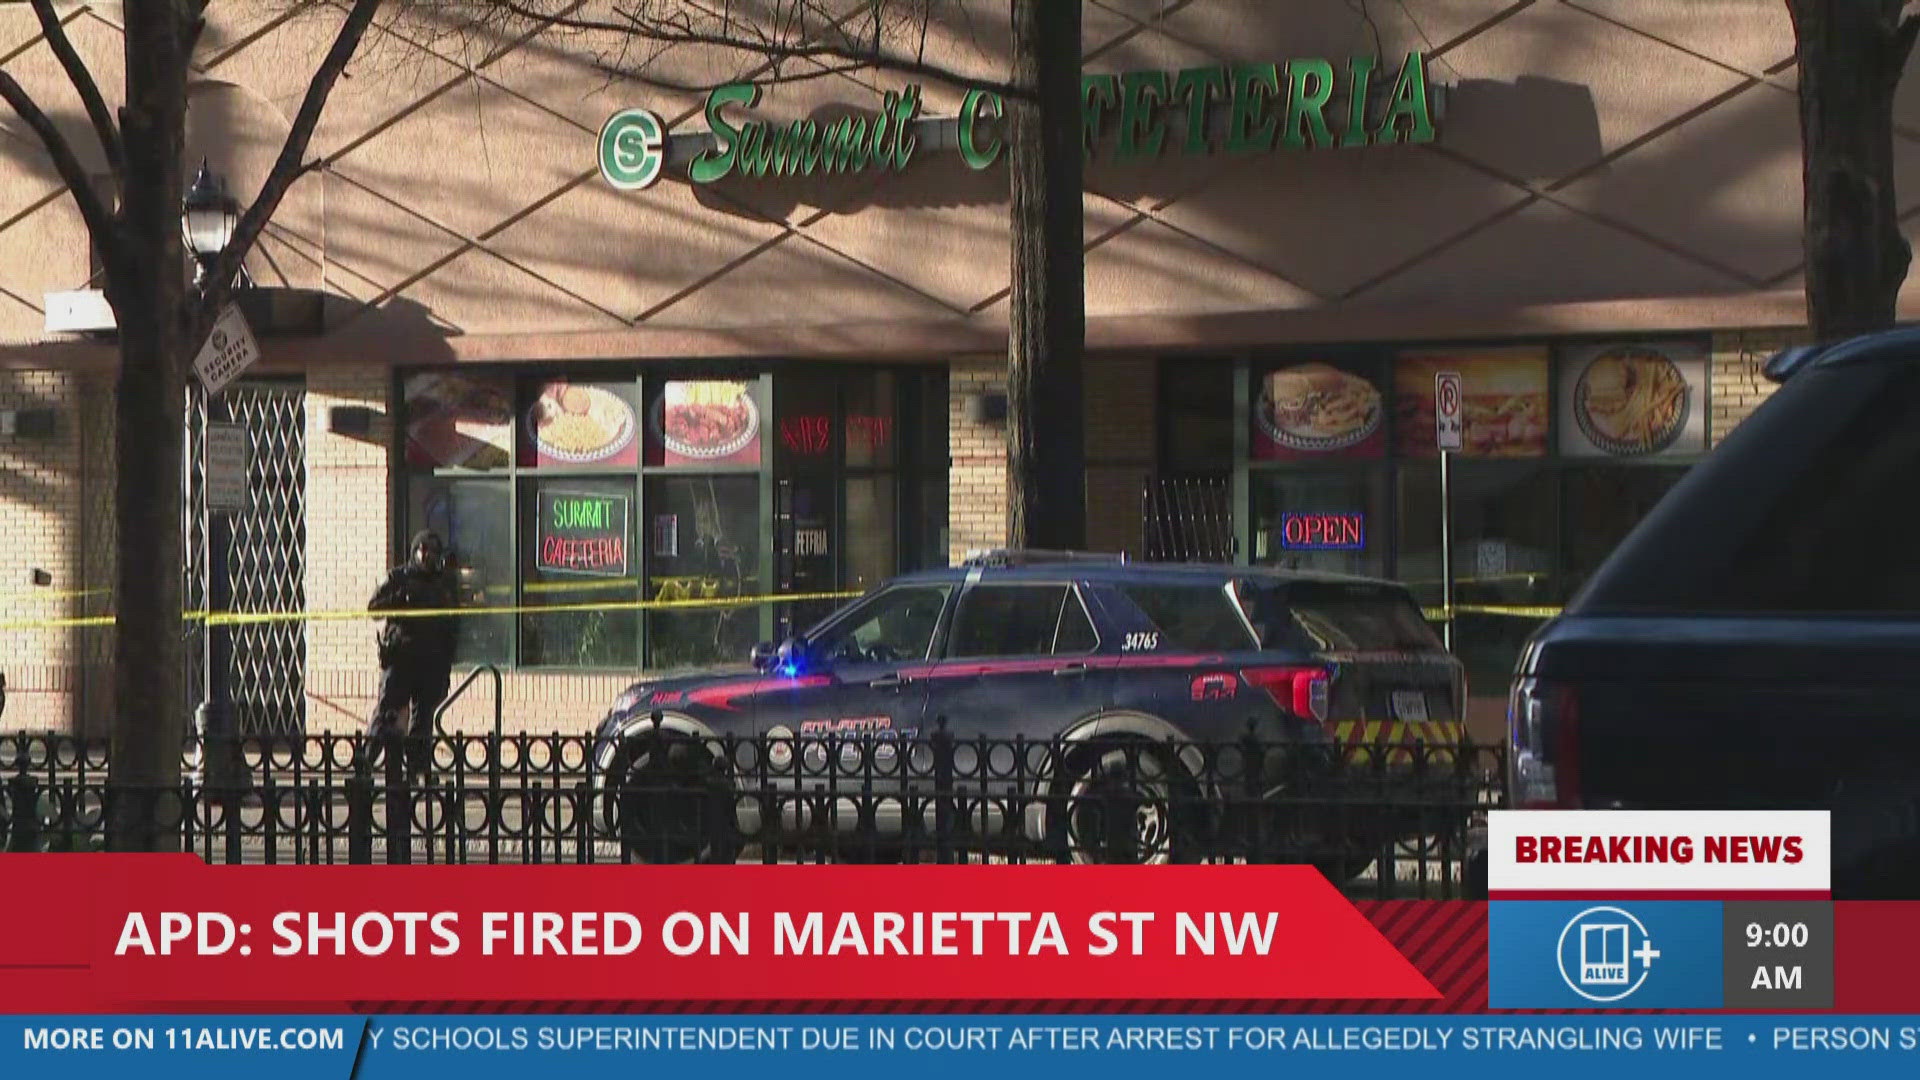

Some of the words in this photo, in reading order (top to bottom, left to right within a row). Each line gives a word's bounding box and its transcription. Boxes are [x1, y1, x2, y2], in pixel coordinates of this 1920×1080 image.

[688, 80, 922, 183] Summit
[956, 50, 1435, 170] CFETERIA
[203, 336, 246, 376] SECURITY
[210, 347, 249, 383] CAMERA
[553, 499, 613, 530] SUMMIT
[1285, 514, 1361, 545] OPEN
[543, 535, 624, 569] CAFETERIA
